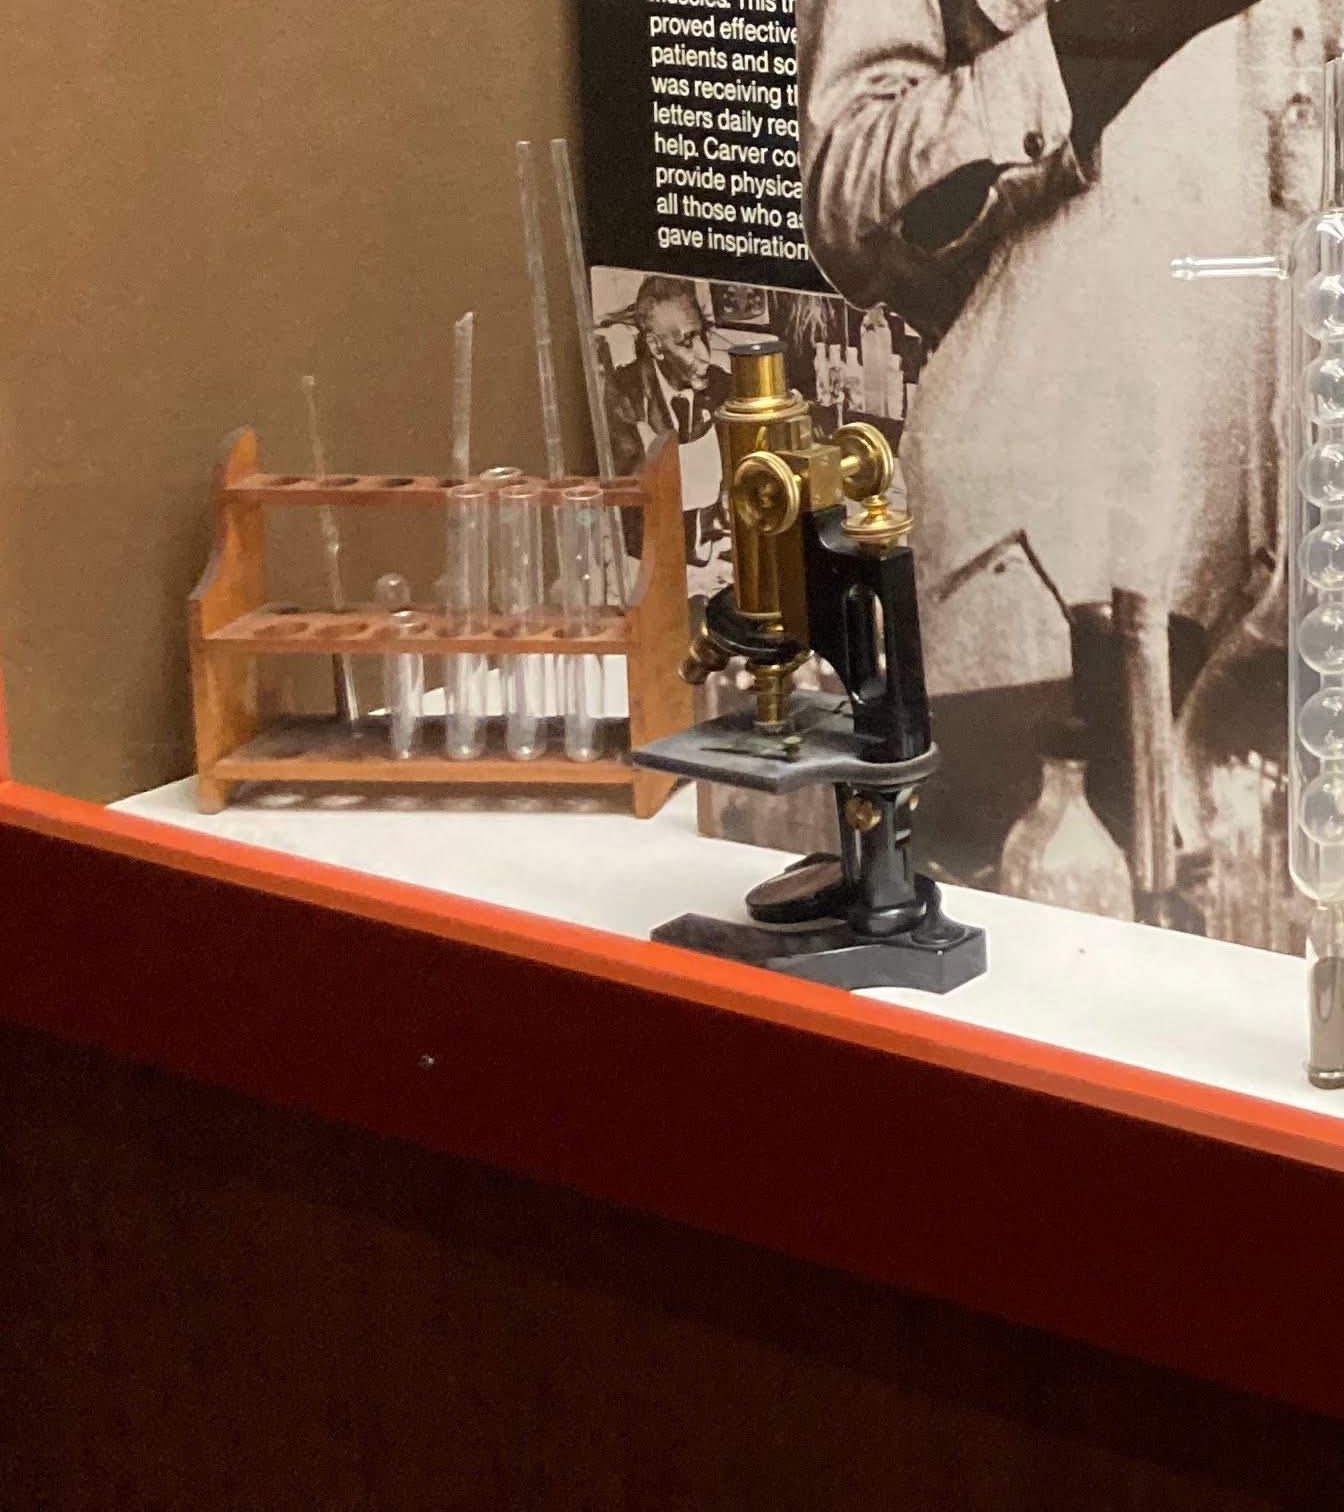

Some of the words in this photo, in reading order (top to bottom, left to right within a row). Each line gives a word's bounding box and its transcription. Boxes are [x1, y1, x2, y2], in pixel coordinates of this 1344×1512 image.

[650, 15, 715, 37] proved
[656, 167, 725, 190] provide
[658, 226, 703, 248] gave
[708, 227, 809, 261] inspiration
